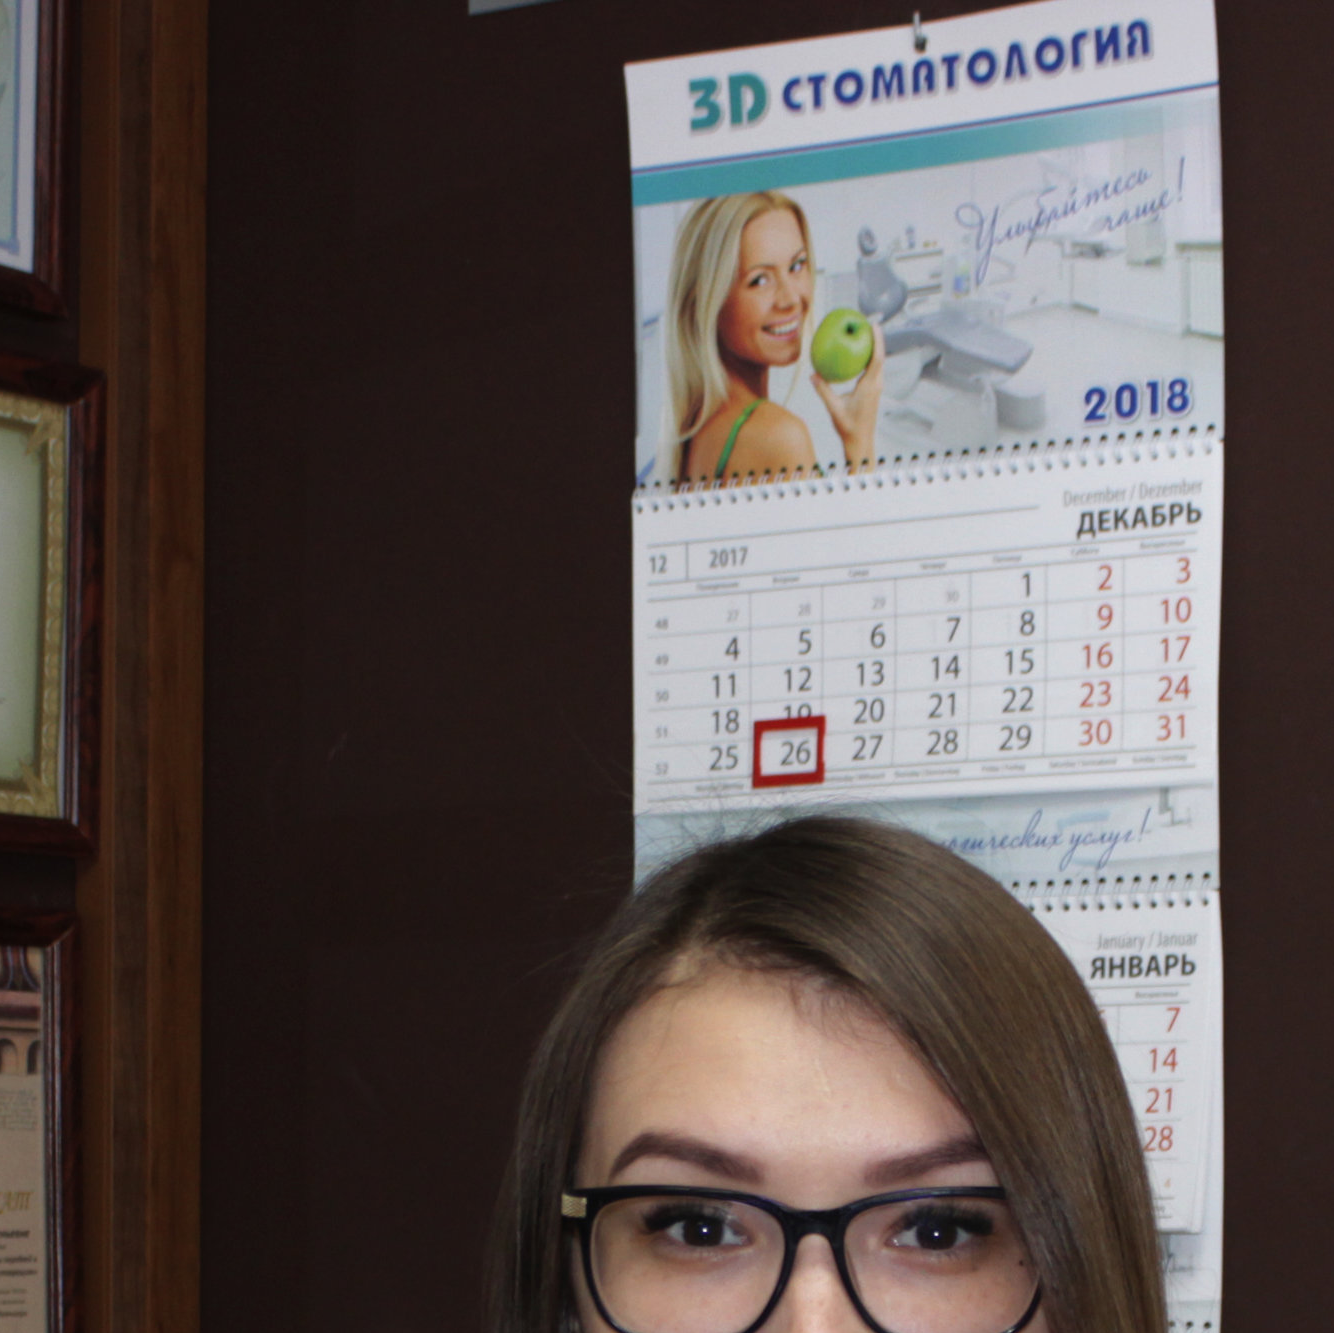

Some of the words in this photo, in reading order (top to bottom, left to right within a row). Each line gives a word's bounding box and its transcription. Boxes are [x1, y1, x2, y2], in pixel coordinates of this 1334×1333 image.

[688, 71, 769, 132] 3D
[782, 18, 1152, 112] СТОМАТОЛОГИЯ
[1104, 156, 1186, 235] чаще!
[955, 167, 1151, 288] Улыбайтесь
[1084, 378, 1191, 423] 2018
[1063, 485, 1127, 507] December
[1139, 479, 1203, 500] Dezember
[1076, 501, 1202, 539] ДЕКАБРЬ
[649, 555, 667, 574] 12
[709, 547, 748, 568] 2017
[1022, 572, 1031, 598] 1
[1097, 565, 1113, 591] 2
[1176, 557, 1192, 584] 3
[724, 636, 740, 661] 4
[798, 629, 812, 655] 5
[870, 623, 886, 648] 6
[946, 616, 961, 643] 7
[1020, 610, 1035, 636] 8
[1097, 604, 1114, 631] 9
[1160, 597, 1192, 624] 10
[712, 673, 737, 697] 11
[784, 667, 812, 692] 12
[857, 660, 885, 687] 13
[931, 655, 961, 681] 14
[1005, 648, 1035, 676] 15
[1082, 642, 1113, 670] 16
[1160, 635, 1191, 663] 17
[712, 709, 739, 734] 18
[854, 698, 884, 724] 20
[928, 692, 956, 718] 21
[1002, 686, 1034, 713] 22
[1079, 681, 1112, 708] 23
[1158, 675, 1191, 702] 24
[709, 745, 738, 771] 25
[780, 740, 811, 766] 26
[852, 735, 883, 761] 27
[926, 729, 958, 756] 28
[999, 725, 1031, 751] 29
[1078, 719, 1113, 746] 30
[1156, 714, 1186, 742] 31
[1097, 933, 1145, 952] January
[1158, 932, 1199, 948] Januar
[1090, 953, 1197, 980] ЯНВАРЬ
[1166, 1007, 1181, 1033] 7
[1149, 1047, 1178, 1073] 14
[1145, 1087, 1173, 1114] 21
[1143, 1125, 1174, 1152] 28
